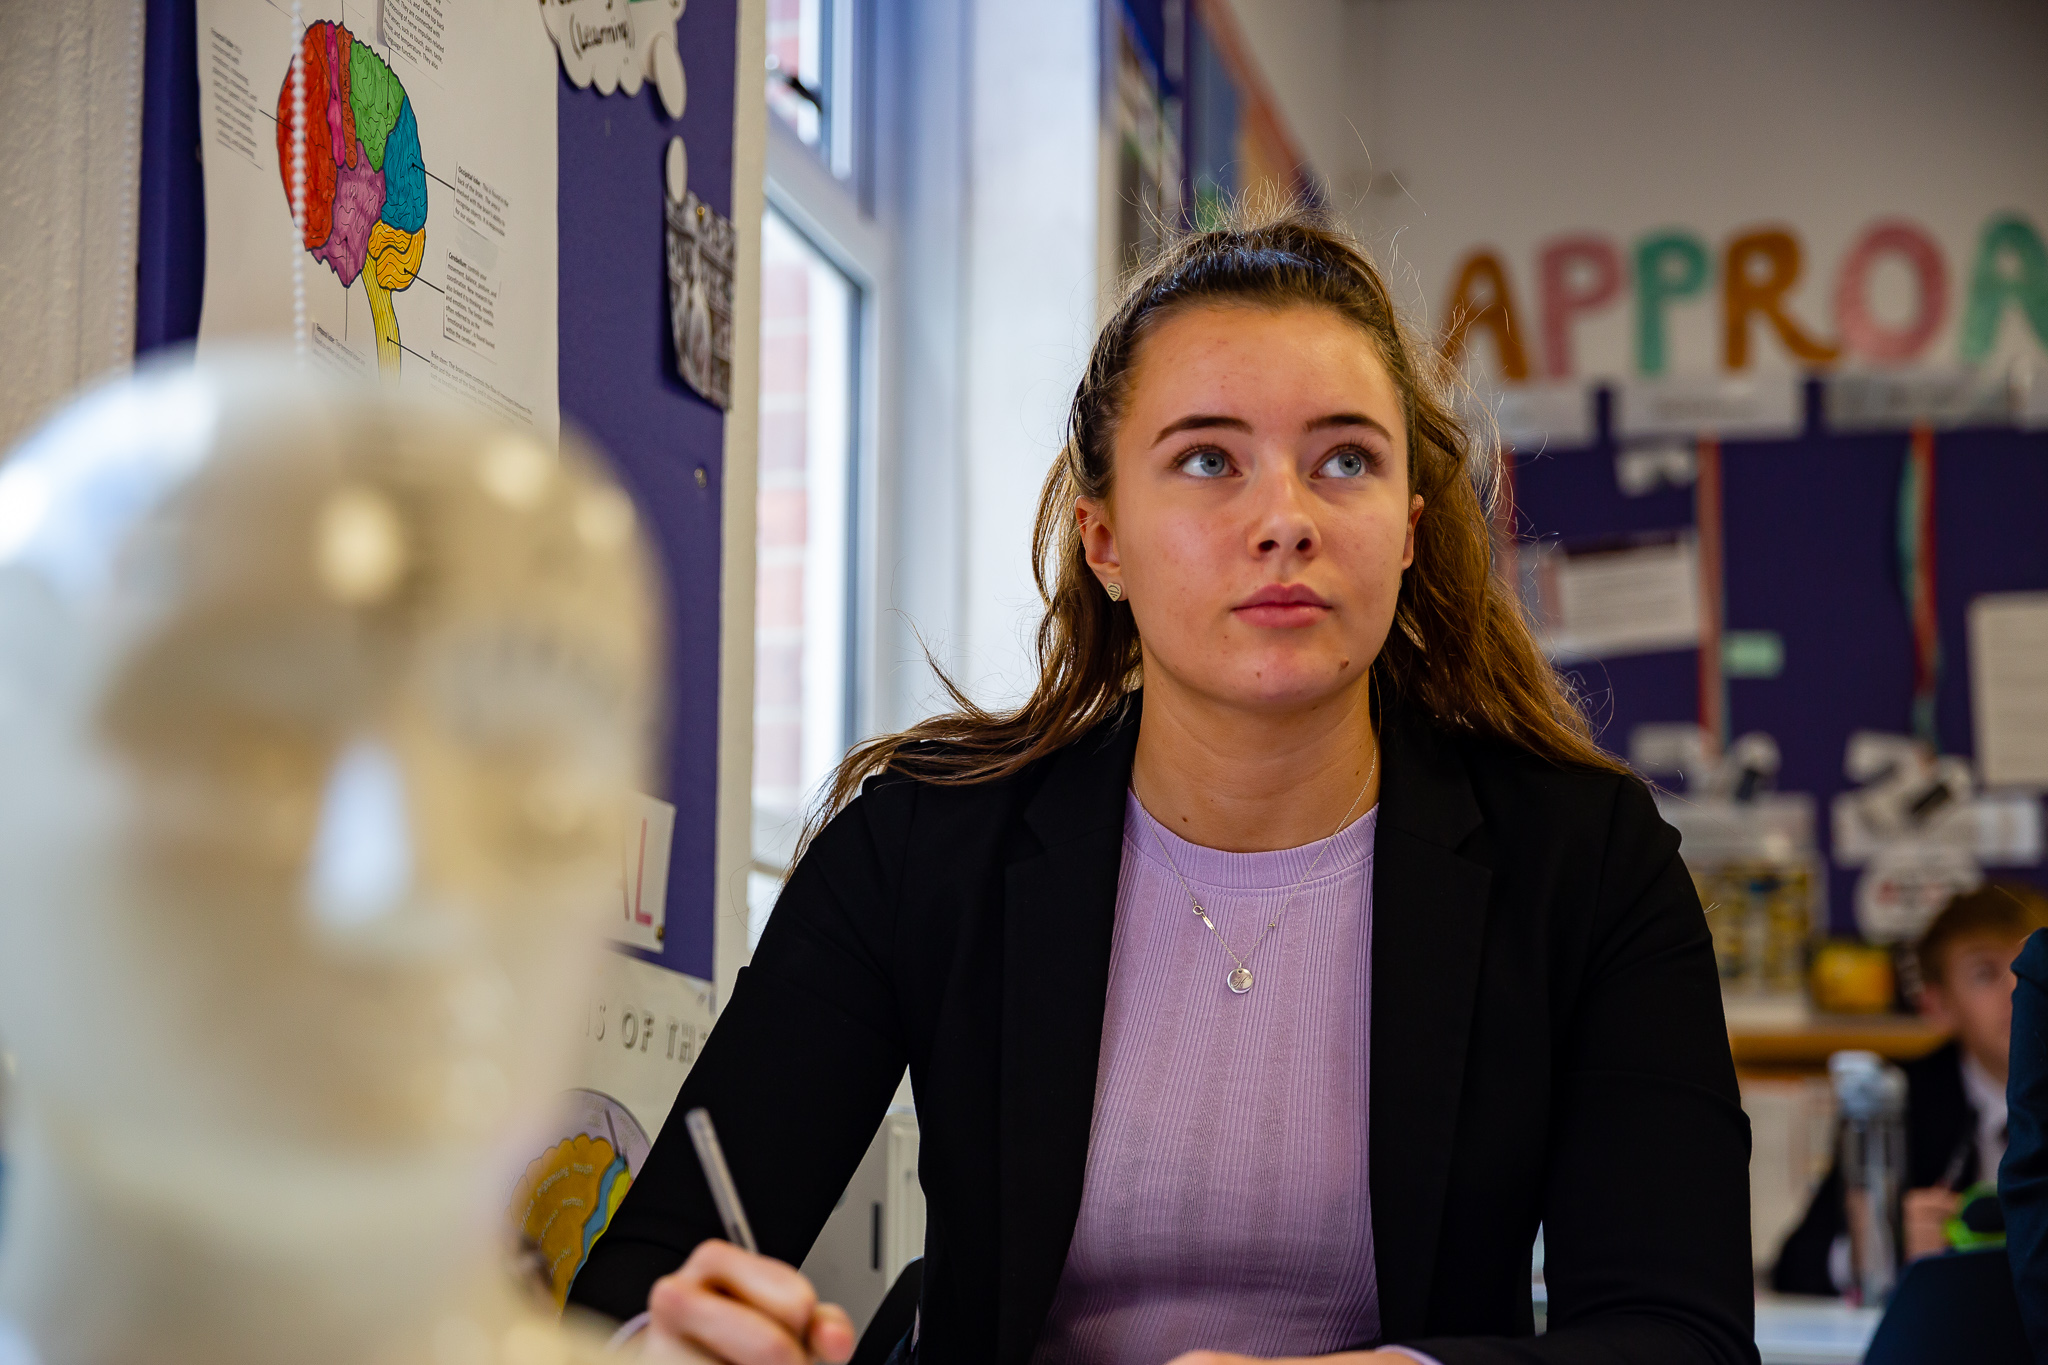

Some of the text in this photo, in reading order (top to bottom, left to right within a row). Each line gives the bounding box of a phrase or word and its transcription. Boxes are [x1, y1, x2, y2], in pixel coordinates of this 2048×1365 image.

[415, 14, 432, 32] connected
[408, 20, 417, 30] nerve
[418, 27, 432, 43] impulses
[433, 41, 444, 53] related
[402, 46, 418, 64] functions.
[414, 36, 424, 49] touch,
[425, 46, 433, 56] pain,
[434, 53, 443, 64] taste,
[458, 166, 472, 180] Occipital
[453, 289, 462, 298] linked
[1438, 208, 2048, 381] APPROA
[446, 305, 454, 314] often
[455, 311, 466, 321] referred
[621, 1003, 655, 1053] OF
